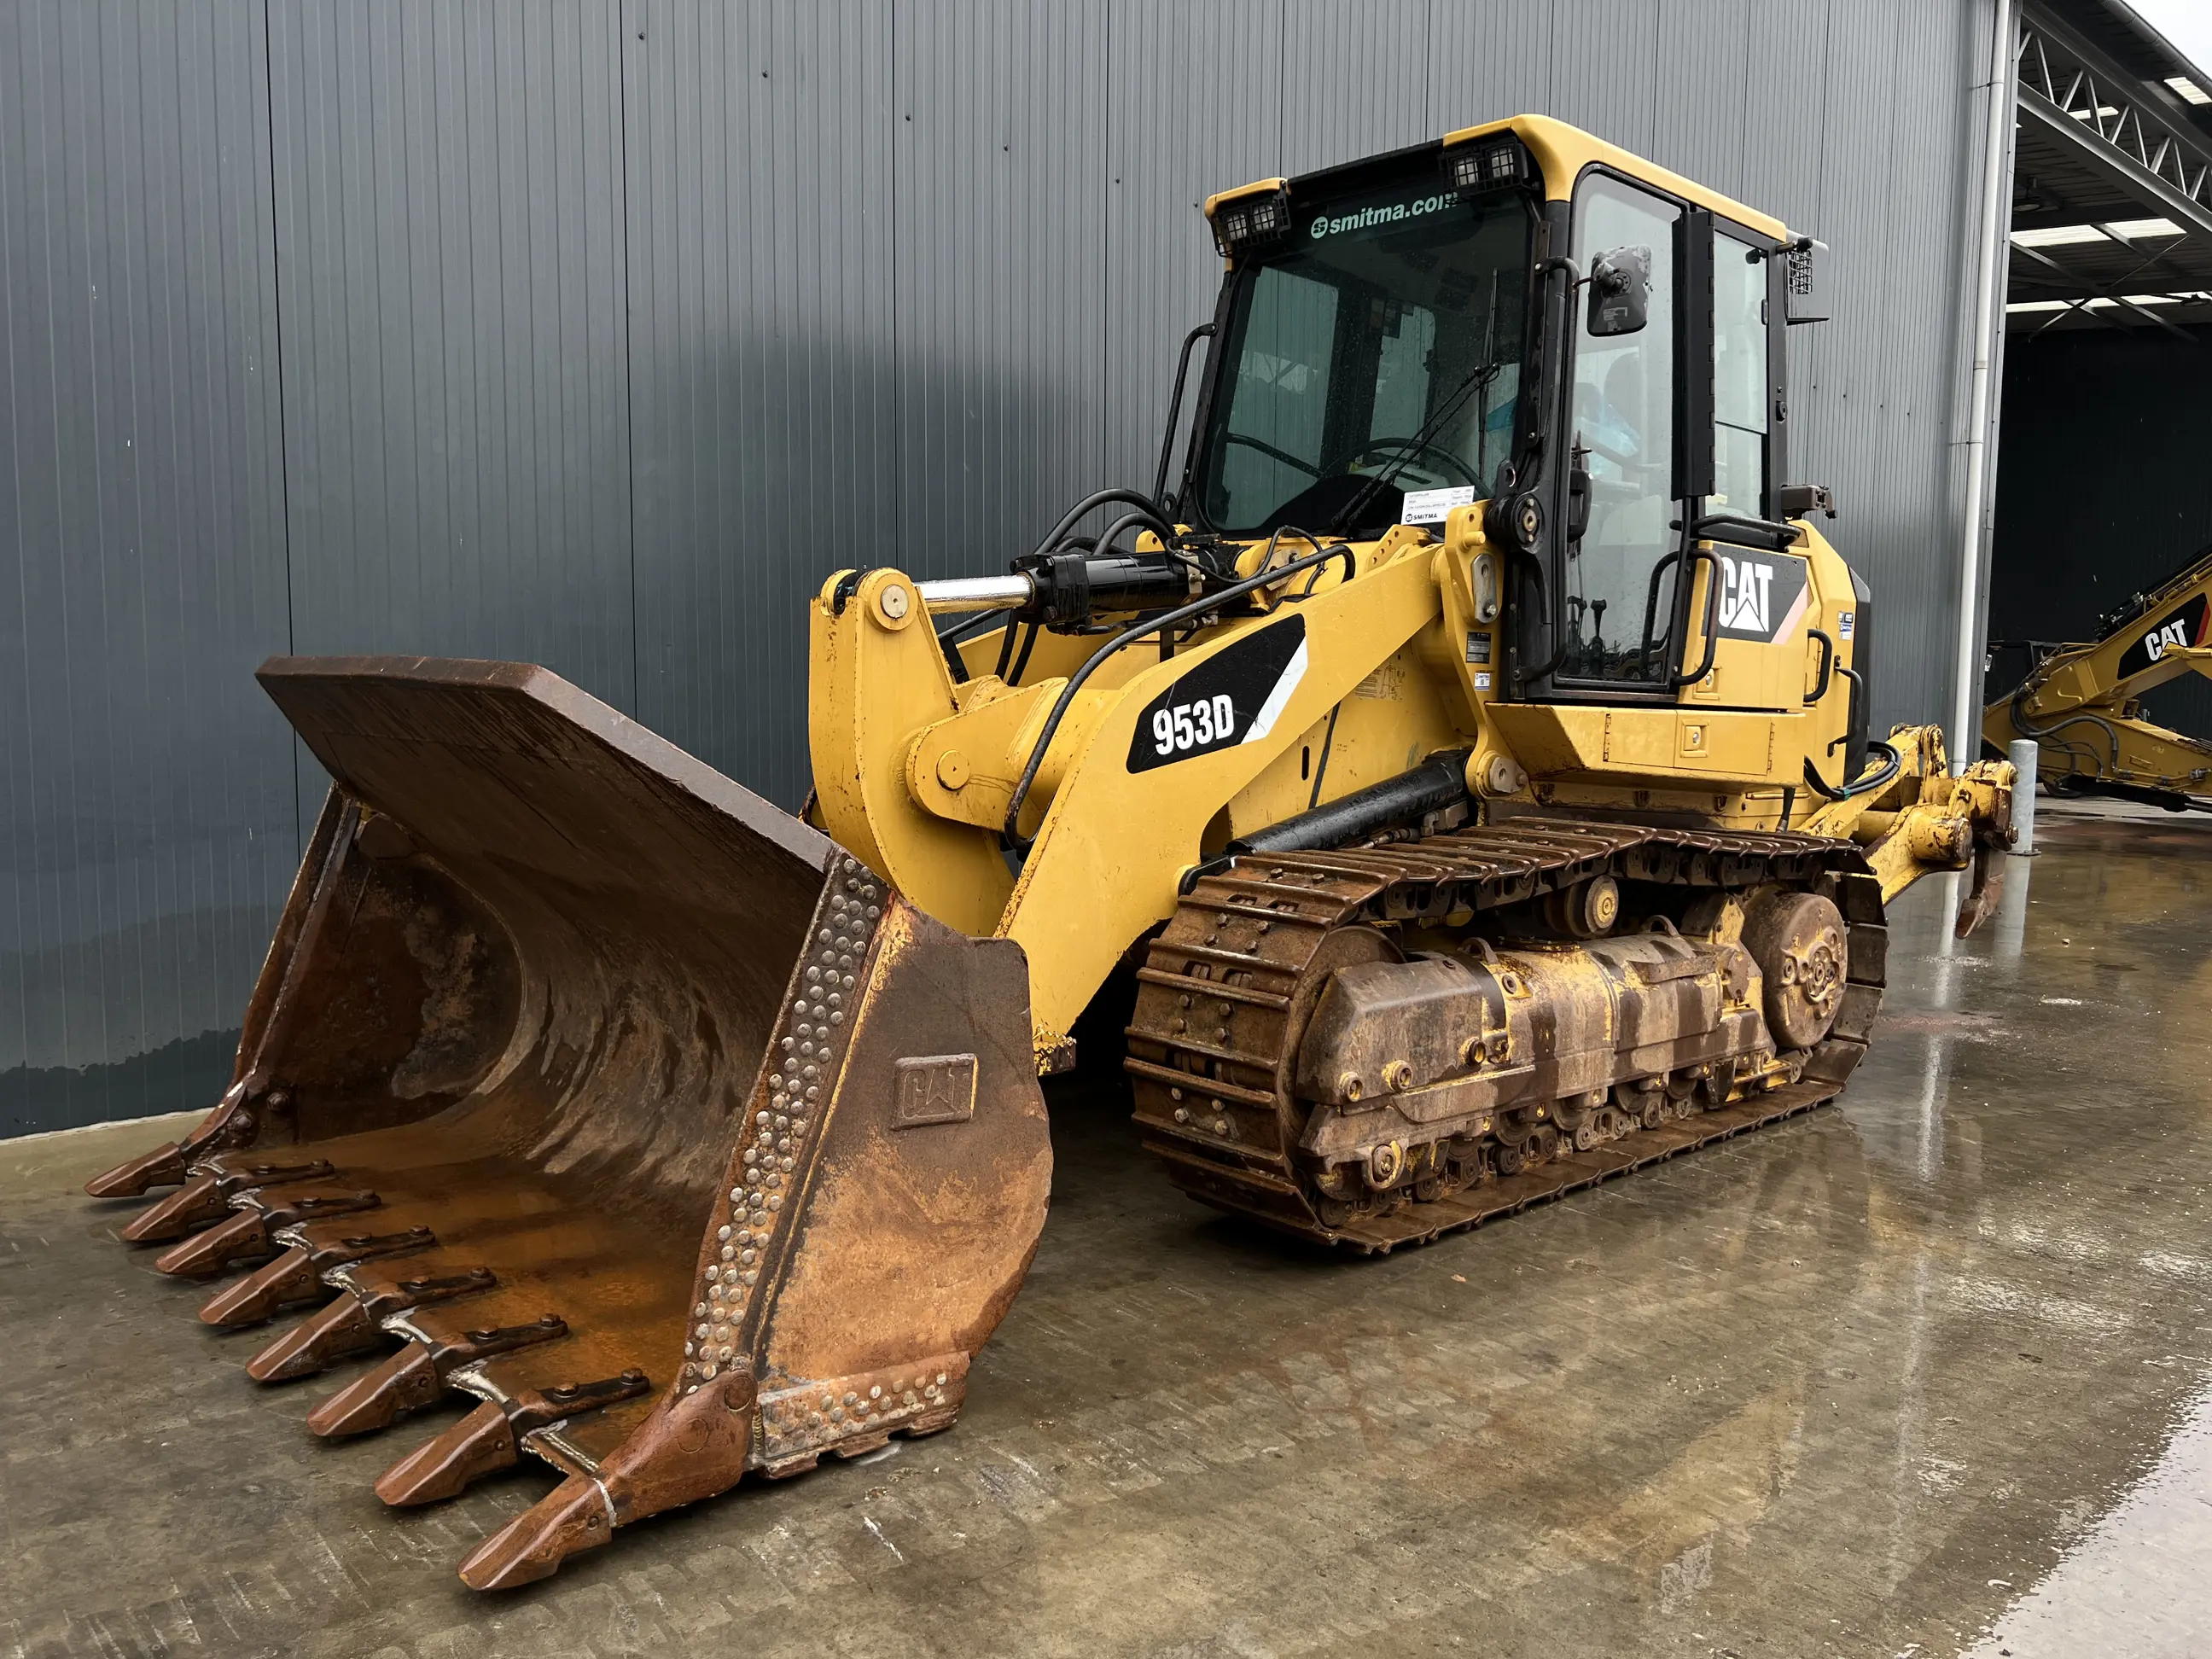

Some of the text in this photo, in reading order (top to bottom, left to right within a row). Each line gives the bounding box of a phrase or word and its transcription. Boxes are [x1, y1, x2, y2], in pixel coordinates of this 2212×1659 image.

[1718, 556, 1773, 632] CAT
[2145, 618, 2188, 661] CAT
[1152, 694, 1234, 755] 953D
[903, 1063, 969, 1120] CAT
